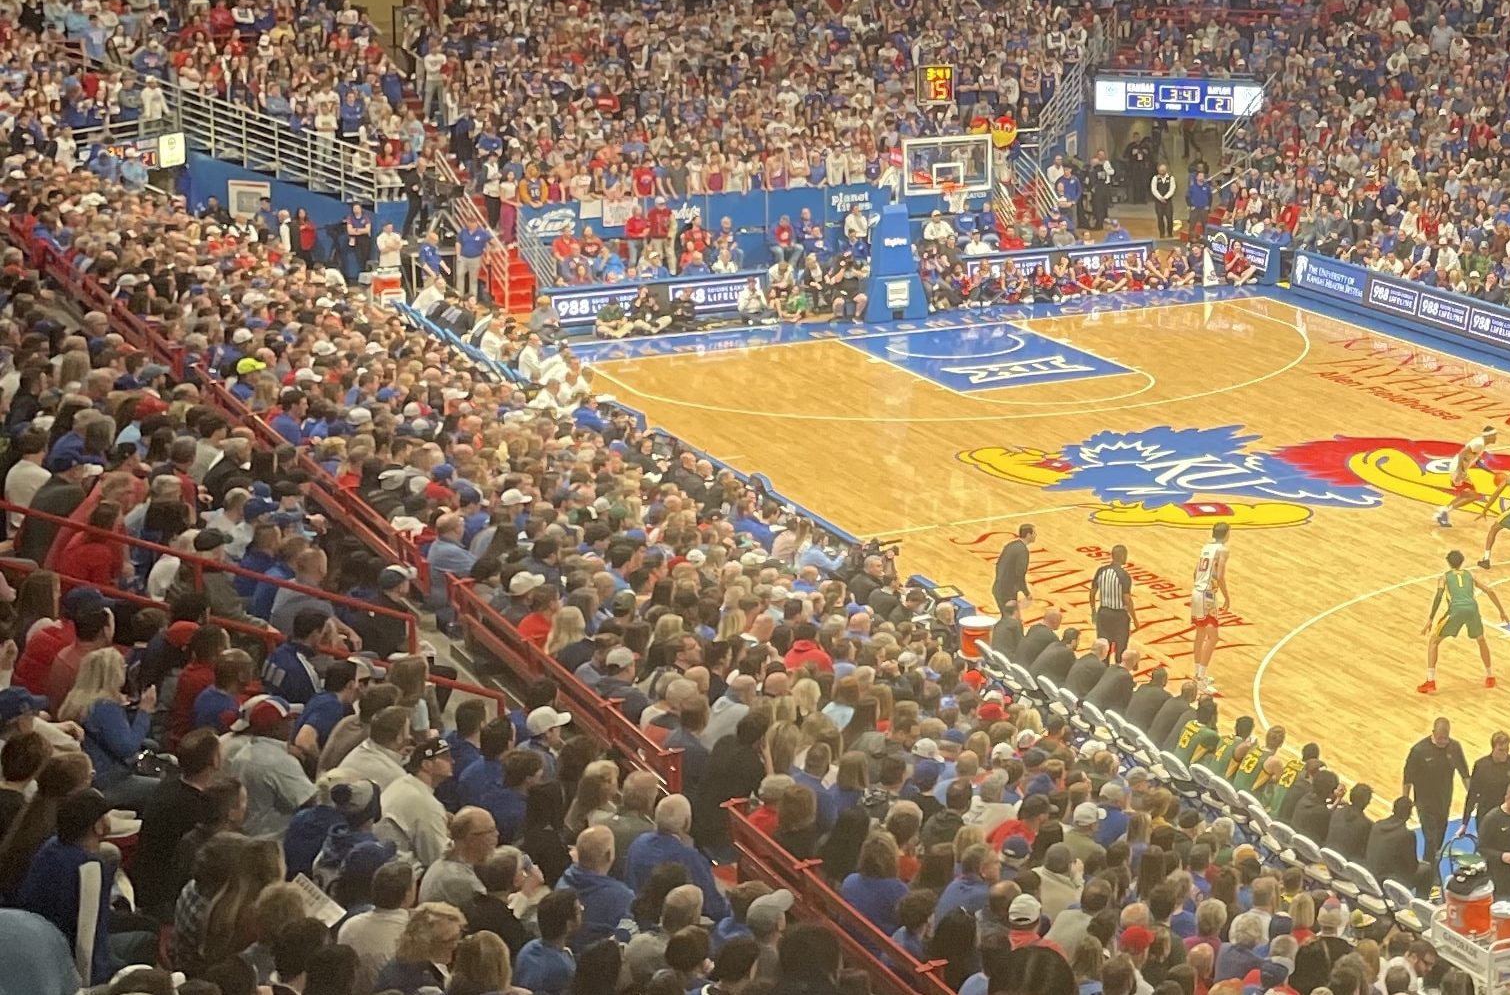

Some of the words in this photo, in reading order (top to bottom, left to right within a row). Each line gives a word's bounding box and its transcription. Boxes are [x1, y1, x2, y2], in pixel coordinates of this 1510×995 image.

[930, 81, 948, 99] 15
[831, 191, 869, 206] planet
[1319, 267, 1348, 285] UNIVERSITY
[1373, 285, 1390, 302] 988
[558, 299, 590, 316] 988
[1422, 300, 1438, 316] 988
[1473, 315, 1490, 332] 988
[1317, 371, 1364, 390] Allen
[1364, 385, 1463, 422] Fieldhouse
[1136, 453, 1277, 490] KU
[1456, 574, 1464, 588] 1
